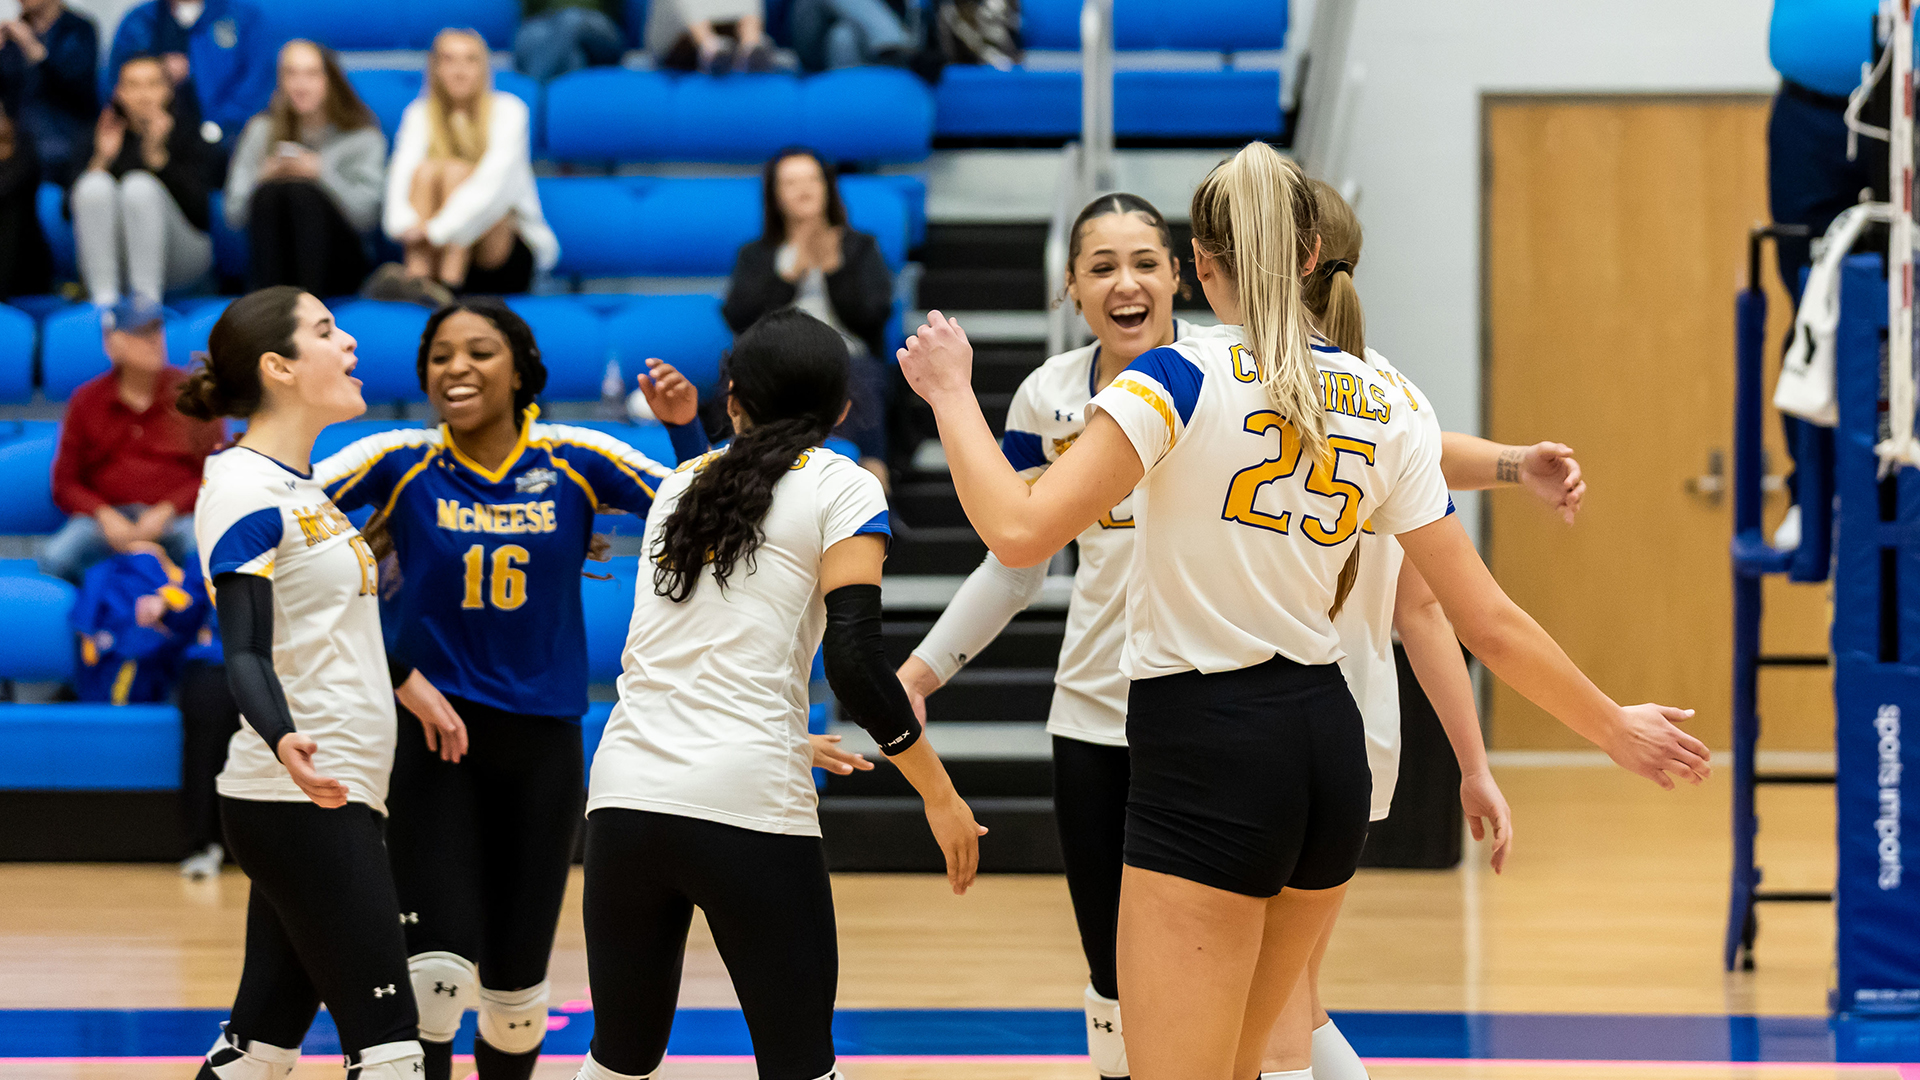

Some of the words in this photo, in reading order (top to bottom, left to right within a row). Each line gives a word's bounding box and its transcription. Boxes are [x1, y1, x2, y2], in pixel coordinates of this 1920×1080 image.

[1229, 343, 1391, 425] CIRLS
[1221, 409, 1377, 547] 25
[462, 544, 530, 610] 16
[1873, 704, 1904, 787] sports
[1873, 788, 1904, 890] imports
